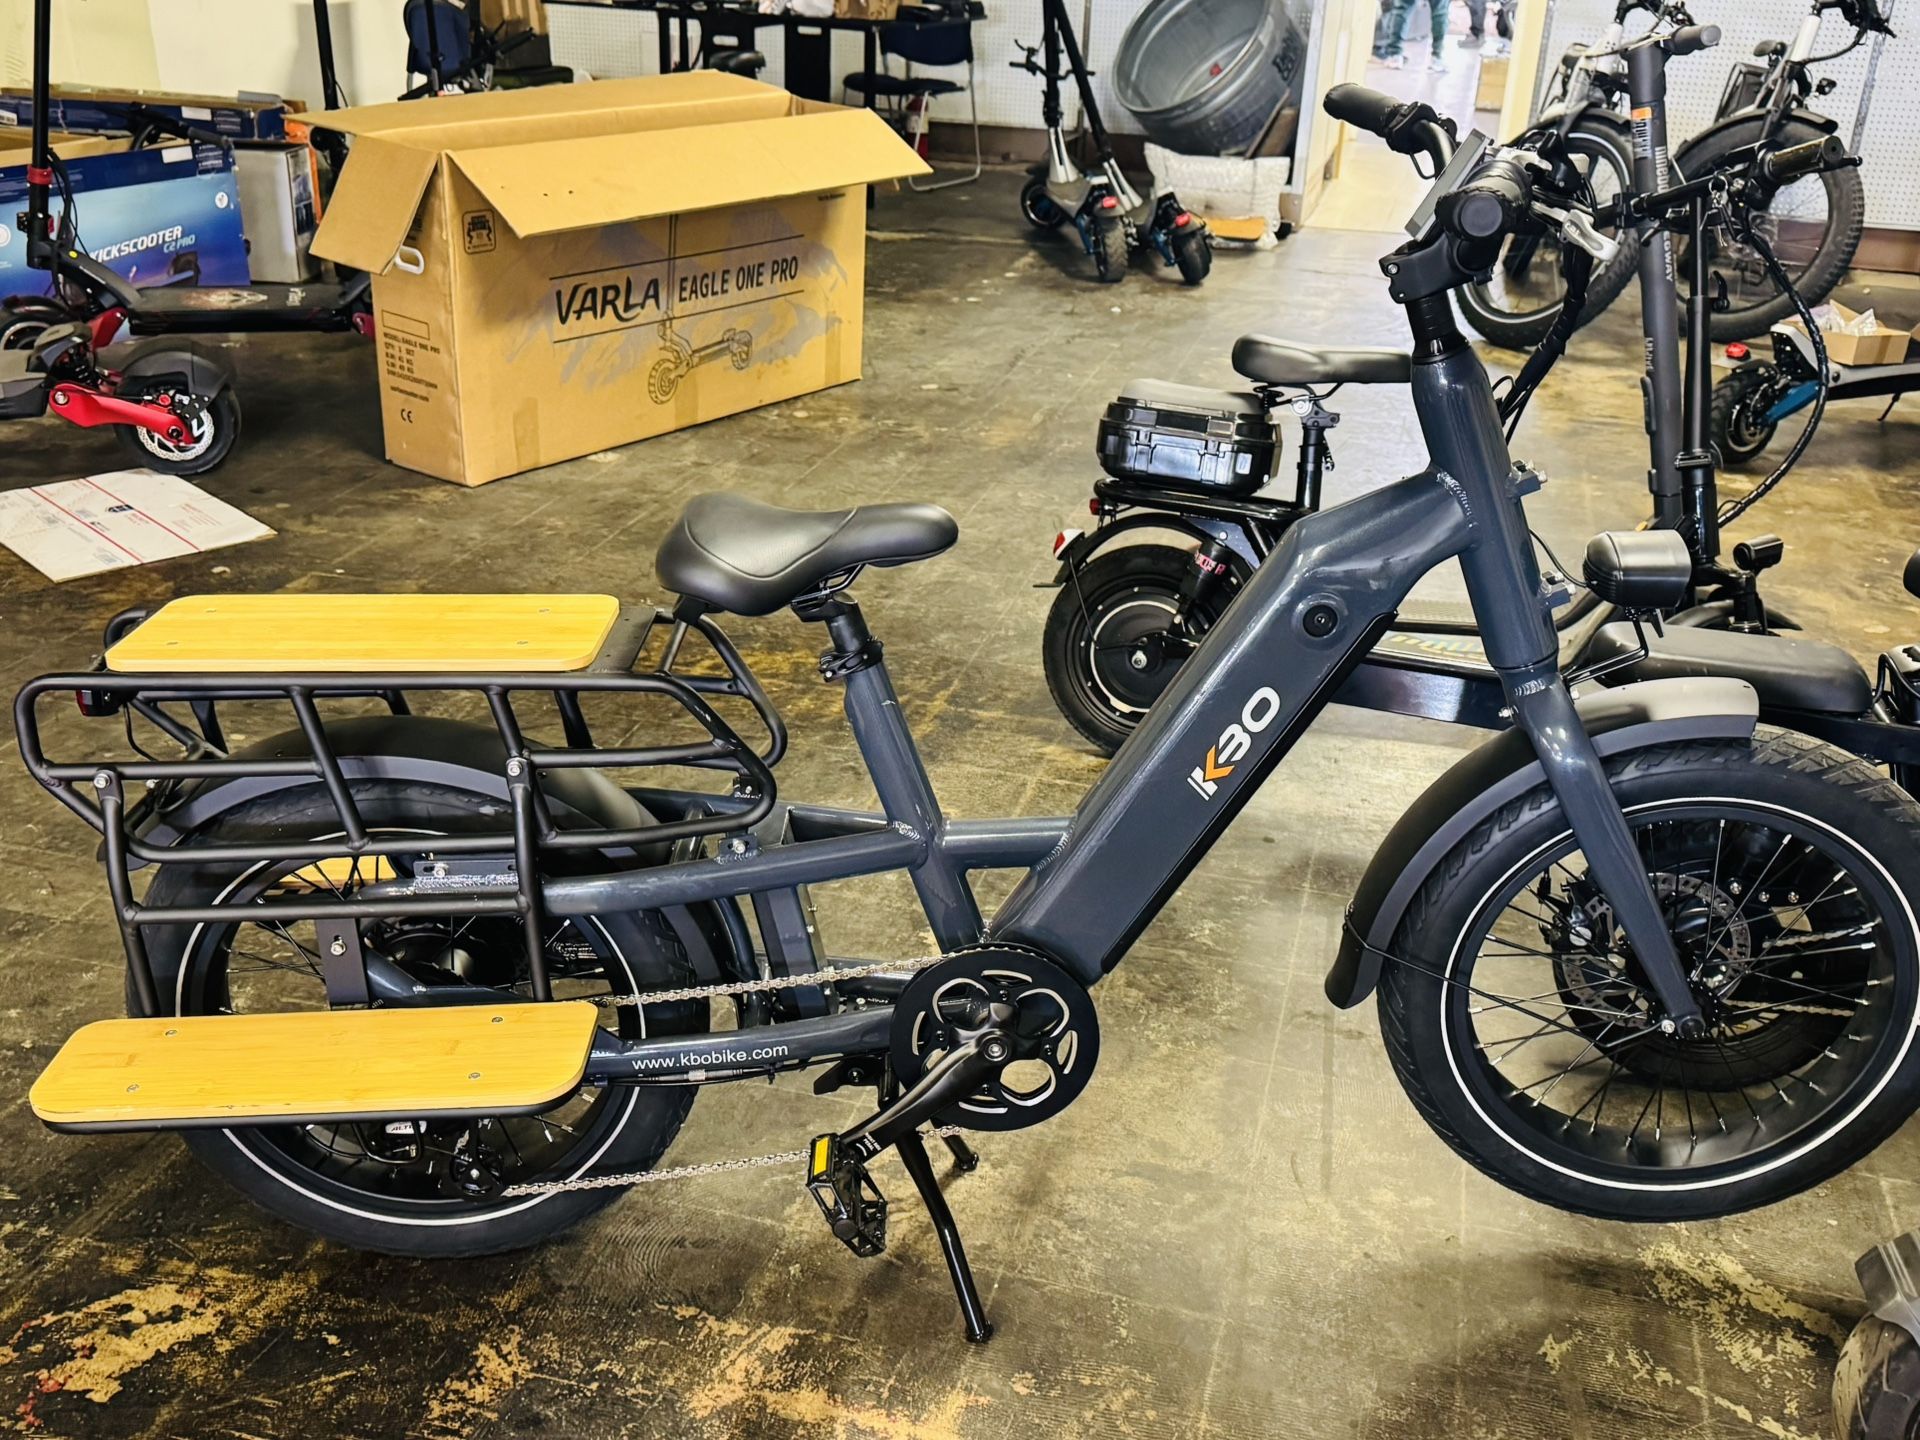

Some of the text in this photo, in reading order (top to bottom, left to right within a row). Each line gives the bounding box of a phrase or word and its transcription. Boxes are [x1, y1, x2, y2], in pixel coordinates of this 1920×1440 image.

[90, 225, 182, 262] KICKSCOOTER
[177, 234, 196, 250] PRO
[1663, 231, 1673, 282] EGWAY
[555, 275, 661, 327] VARLA
[678, 255, 798, 303] EAGLE ONE PRO
[1186, 686, 1281, 801] KBO
[631, 1044, 789, 1071] www.kbobike.com
